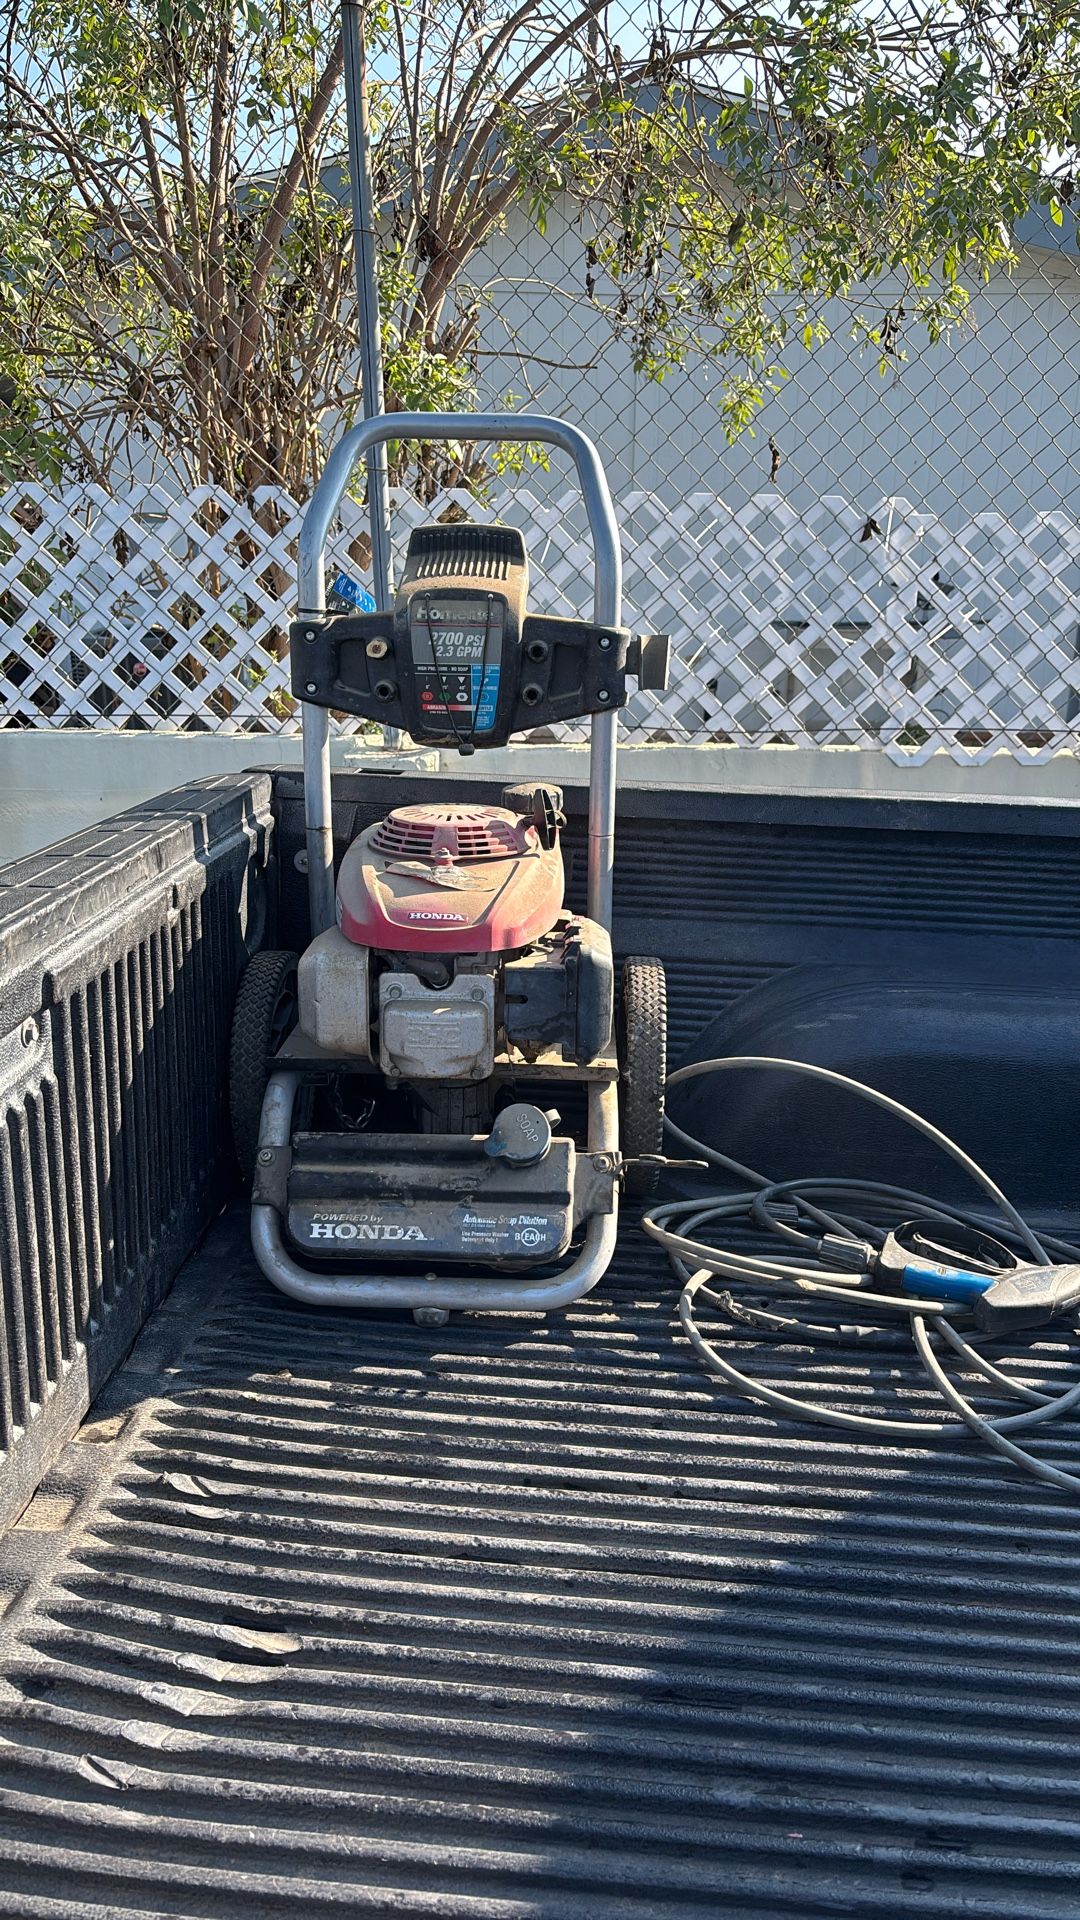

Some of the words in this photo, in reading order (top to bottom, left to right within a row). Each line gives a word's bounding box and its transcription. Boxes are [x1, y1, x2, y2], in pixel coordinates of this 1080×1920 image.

[428, 632, 463, 646] 2700
[465, 634, 486, 646] PSI
[436, 646, 454, 657] 2.3
[456, 646, 483, 658] GPM
[409, 912, 465, 921] HONDA
[517, 1113, 539, 1142] SOAP
[313, 1213, 368, 1222] POWERED
[370, 1215, 383, 1223] by
[462, 1213, 497, 1224] Automatic
[498, 1214, 517, 1226] Soap
[518, 1215, 548, 1226] Dilution
[309, 1223, 428, 1240] HONDA
